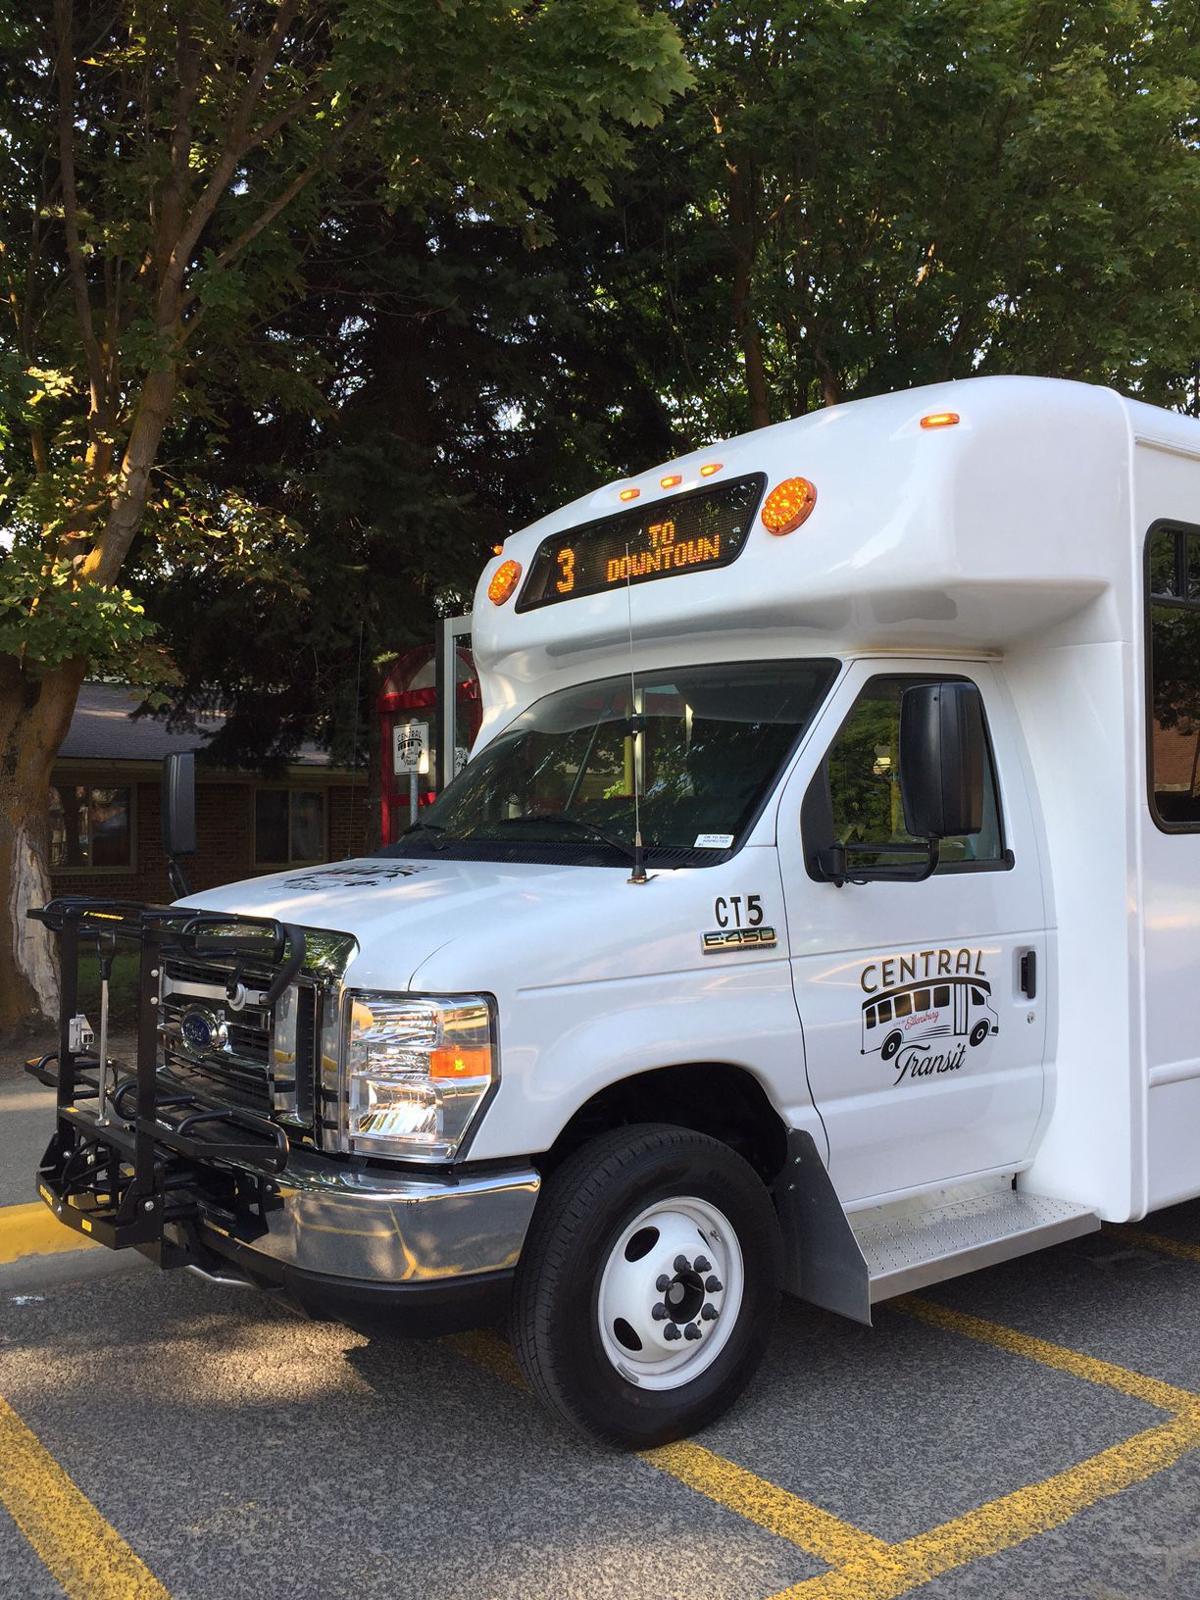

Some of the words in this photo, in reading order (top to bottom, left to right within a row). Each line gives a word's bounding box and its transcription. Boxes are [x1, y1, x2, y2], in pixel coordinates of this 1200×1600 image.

[648, 520, 675, 548] TO
[556, 548, 576, 593] 3
[606, 534, 721, 583] DOWNTOWN
[715, 894, 764, 928] CT5
[860, 948, 986, 994] CENTRAL
[892, 1042, 967, 1086] Transit
